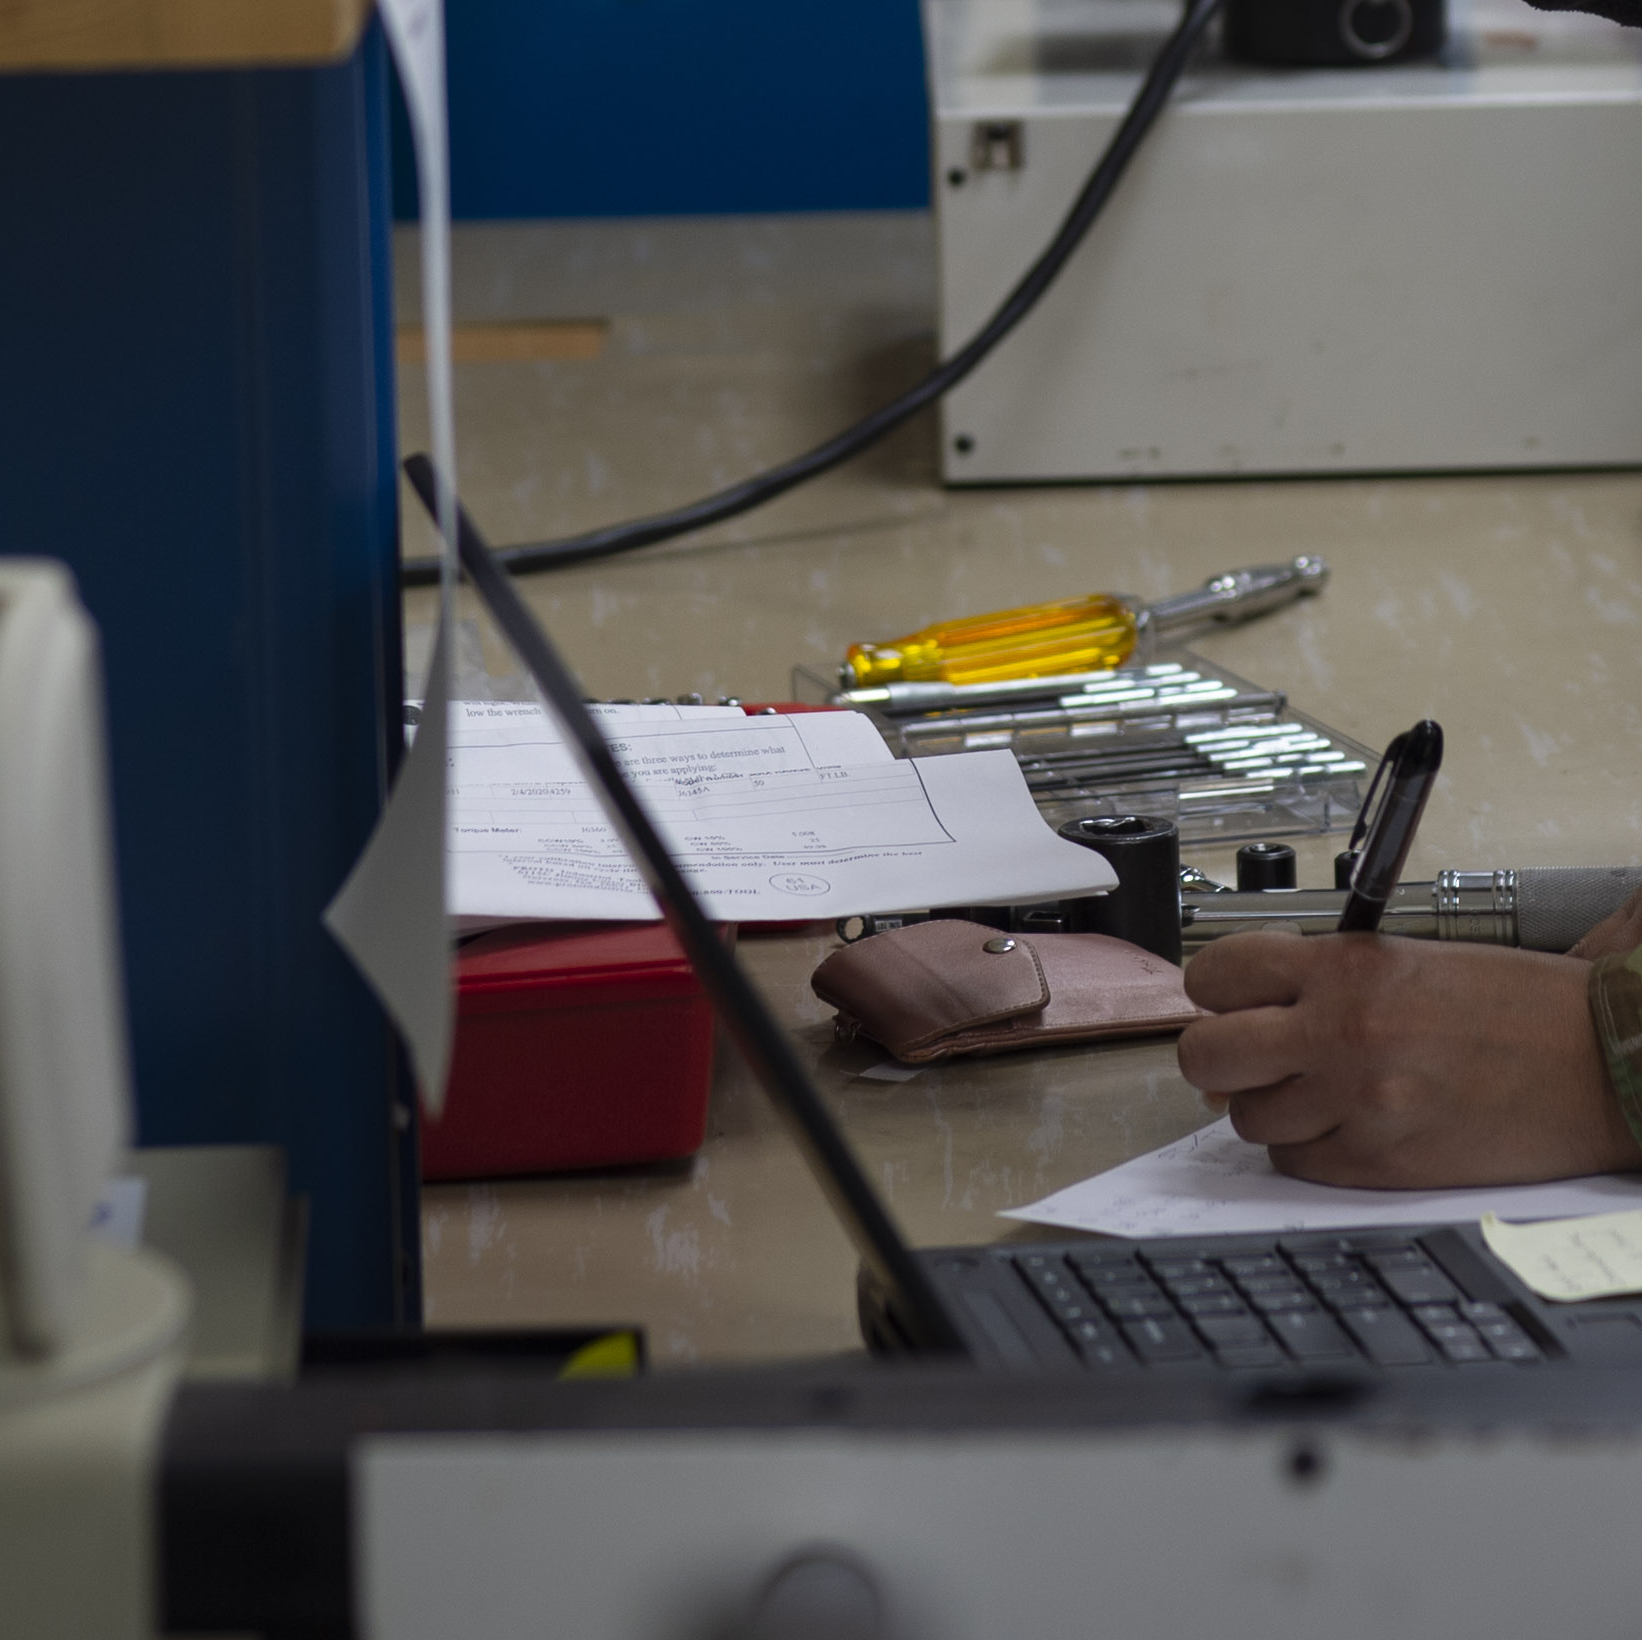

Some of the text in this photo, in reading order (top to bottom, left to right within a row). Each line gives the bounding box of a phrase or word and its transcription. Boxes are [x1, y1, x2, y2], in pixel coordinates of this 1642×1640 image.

[466, 707, 485, 717] low
[488, 707, 503, 717] the
[505, 707, 541, 717] wrench
[624, 745, 786, 767] are three ways to determine what
[632, 769, 651, 782] you
[653, 767, 669, 776] are
[784, 883, 824, 892] USA
